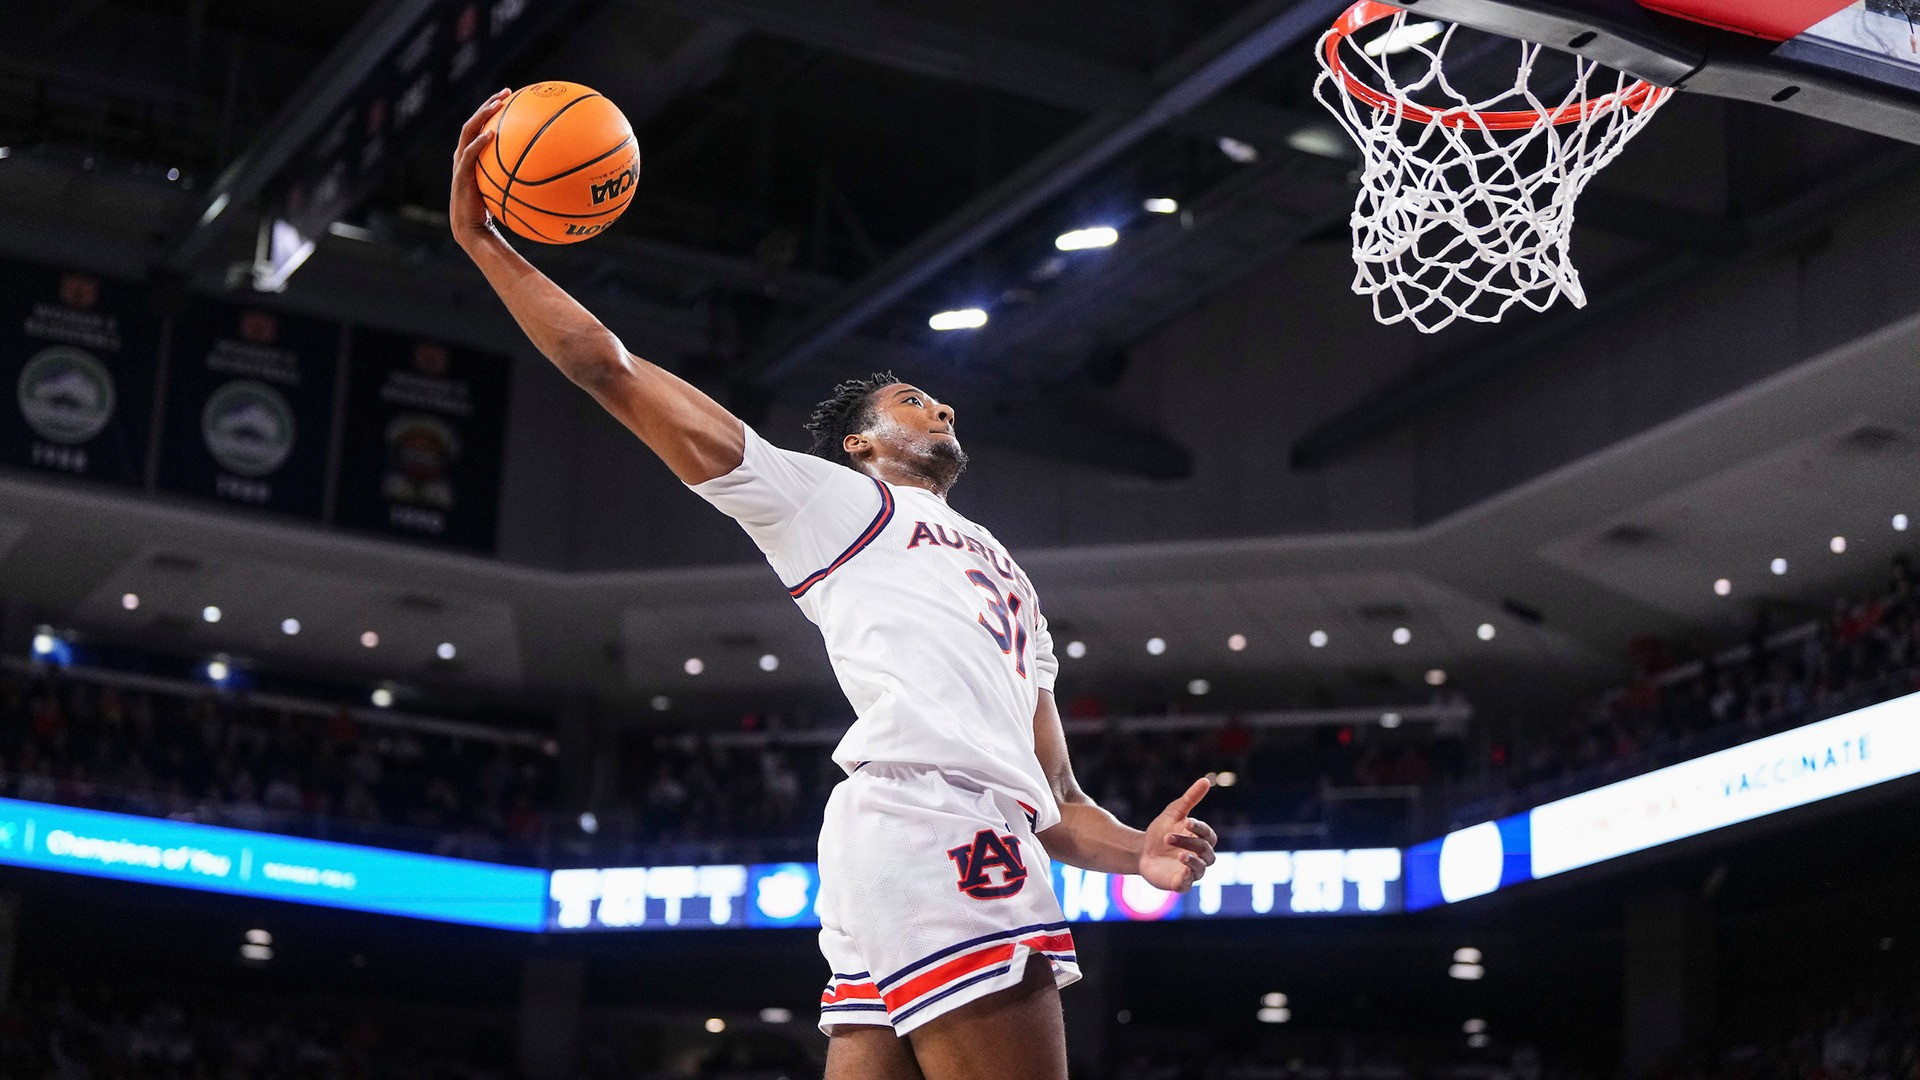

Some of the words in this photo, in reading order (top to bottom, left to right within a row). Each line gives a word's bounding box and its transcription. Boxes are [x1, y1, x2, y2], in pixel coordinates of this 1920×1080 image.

[590, 162, 639, 206] NCAA
[965, 569, 1027, 679] 31
[47, 830, 161, 868] Champions
[162, 846, 189, 870] of
[189, 849, 231, 877] You
